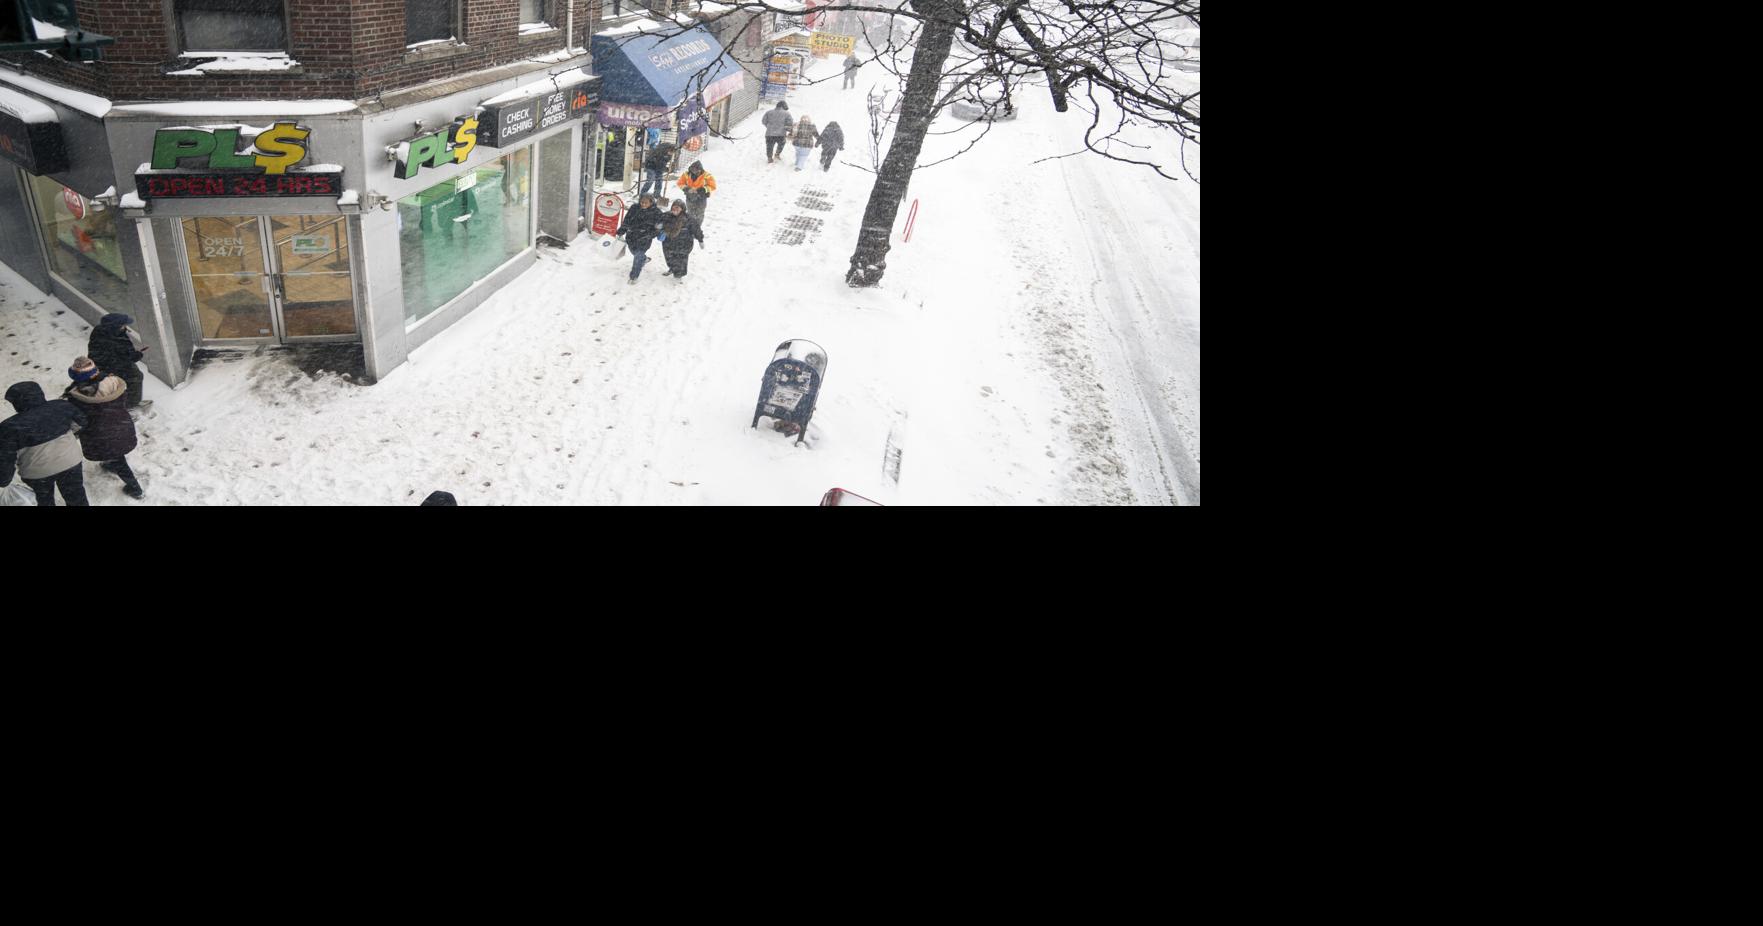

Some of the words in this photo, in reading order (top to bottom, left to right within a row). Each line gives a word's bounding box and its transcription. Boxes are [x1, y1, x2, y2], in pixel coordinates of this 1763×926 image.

[814, 40, 849, 49] STUDIO
[815, 33, 849, 43] PHOTO
[572, 91, 587, 110] ria
[506, 108, 530, 124] CHECK
[544, 101, 566, 117] MONEY
[541, 110, 567, 128] ORDERS
[501, 119, 533, 138] CASHING
[149, 176, 225, 196] OPEN
[234, 178, 267, 194] 24
[277, 177, 332, 193] HRS
[205, 246, 244, 257] 24/7
